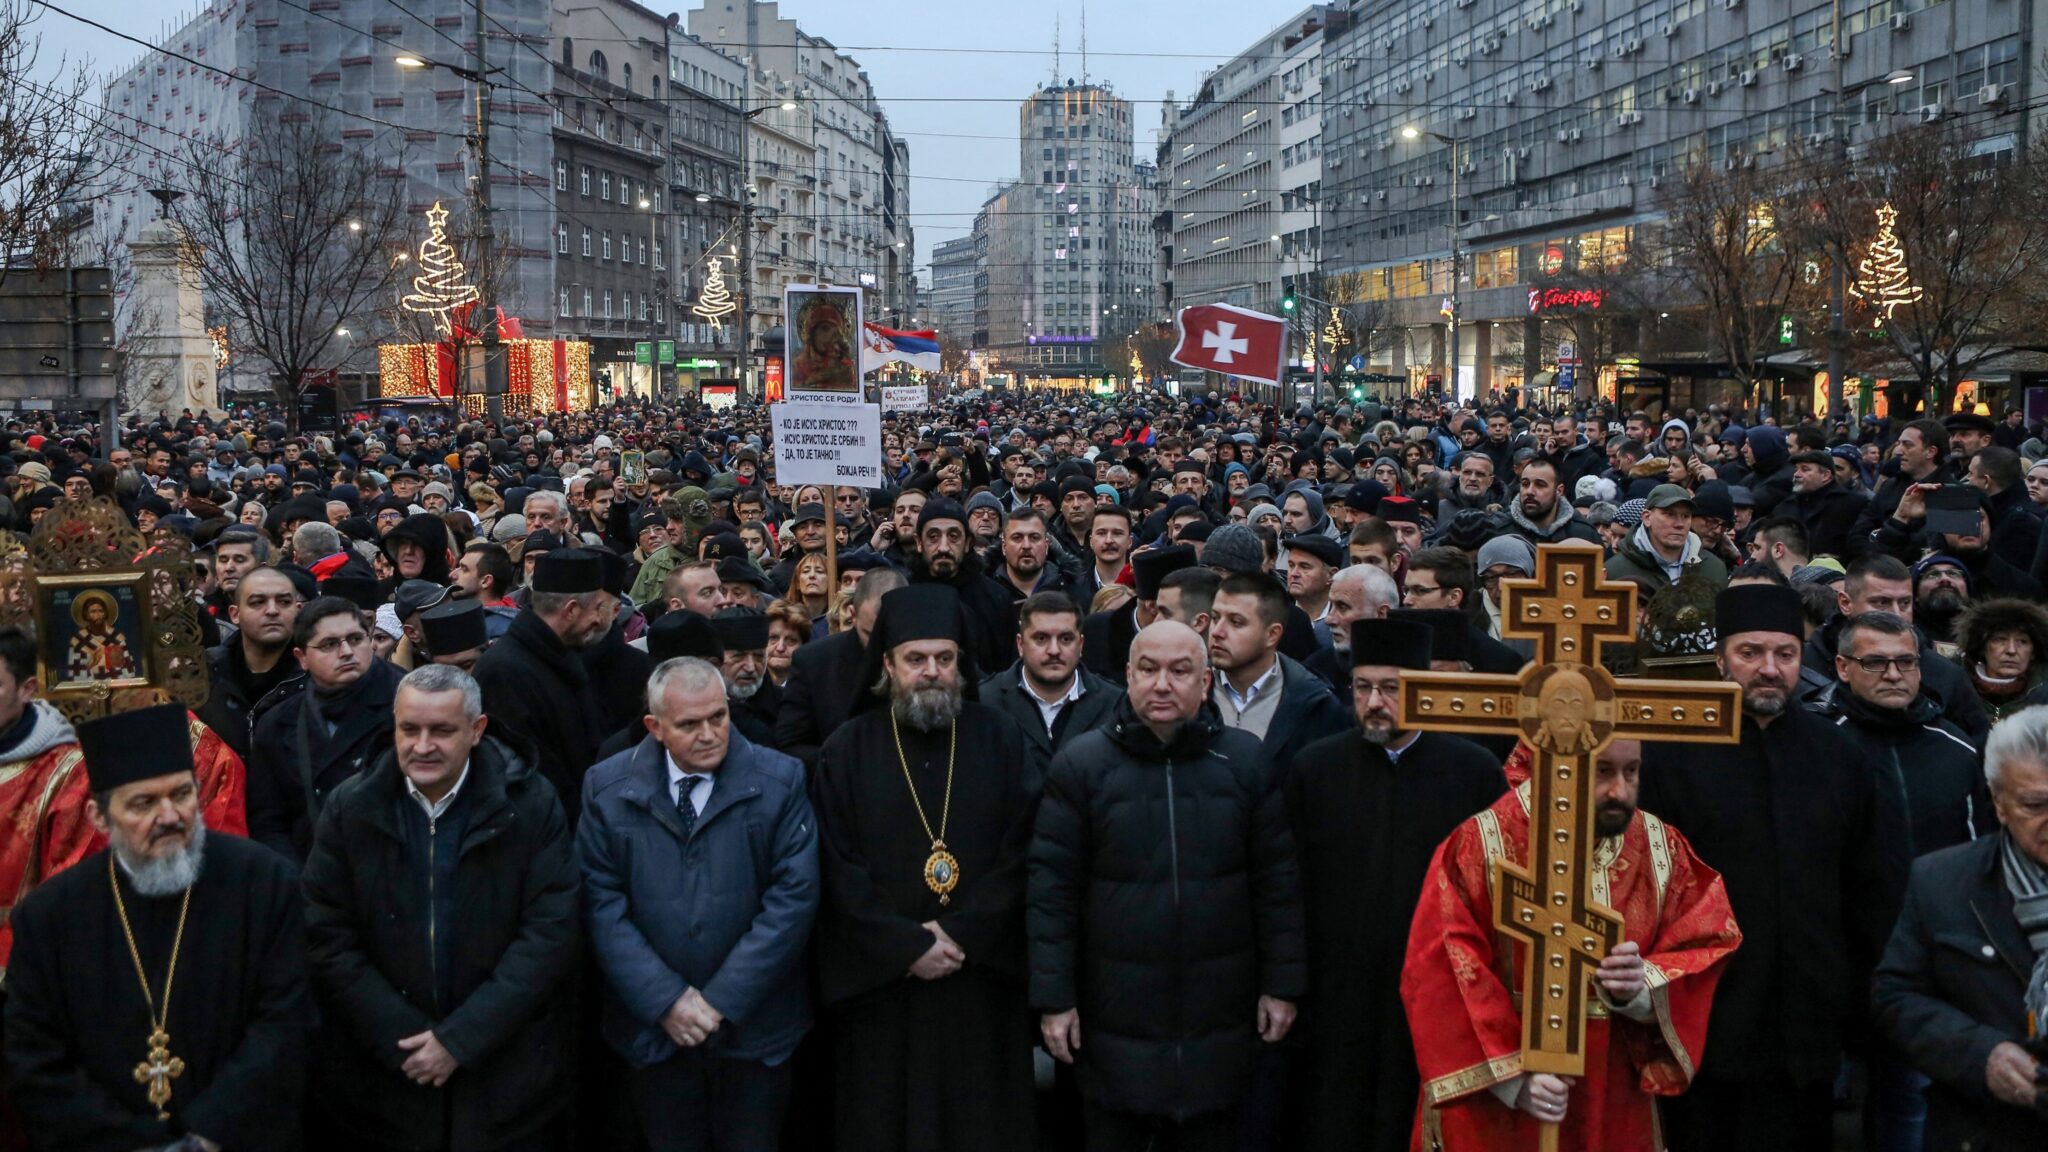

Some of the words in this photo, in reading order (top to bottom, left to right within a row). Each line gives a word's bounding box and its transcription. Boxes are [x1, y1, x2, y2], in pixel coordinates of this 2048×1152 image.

[790, 394, 824, 402] ХРИСТОС
[837, 395, 857, 404] РОДИ
[783, 418, 792, 430] КО
[793, 418, 800, 430] ЈЕ
[801, 418, 818, 430] ИСУС
[818, 419, 846, 431] ХРИСТОС
[784, 433, 801, 445] ИСУС
[801, 434, 829, 445] ХРИСТОС
[831, 434, 838, 446] ЈЕ
[839, 435, 858, 446] СРБИН
[785, 448, 796, 460] ДА,
[796, 448, 804, 459] ТО
[805, 449, 813, 460] ЈЕ
[814, 449, 834, 460] ТАЧНО
[836, 465, 858, 476] БОЖЈА
[858, 465, 870, 477] РЕЧ
